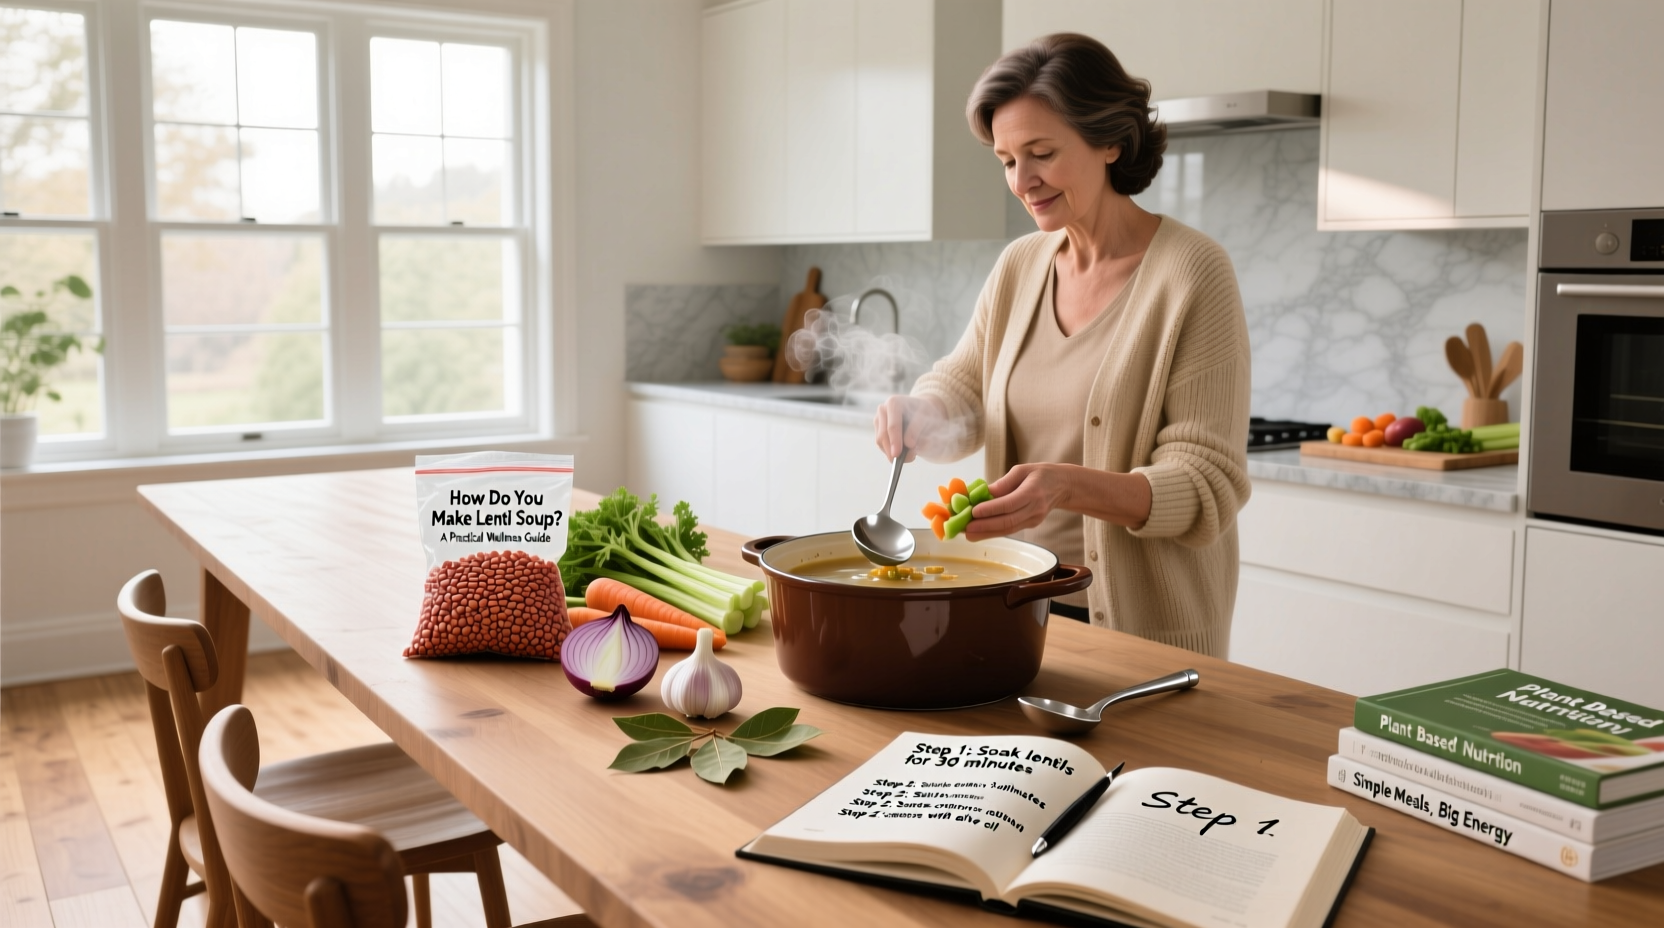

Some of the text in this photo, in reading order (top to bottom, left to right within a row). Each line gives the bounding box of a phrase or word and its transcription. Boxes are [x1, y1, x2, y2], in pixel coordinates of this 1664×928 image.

[450, 489, 544, 506] How Do You
[432, 510, 472, 526] Make
[516, 509, 563, 531] Soup?
[440, 532, 448, 543] A
[524, 531, 551, 543] Guide
[1379, 714, 1413, 739] Plant
[1416, 725, 1458, 753] Based
[905, 754, 931, 766] for
[934, 756, 960, 767] 30
[912, 743, 952, 757] Step
[977, 745, 1021, 759] Soak
[1141, 790, 1238, 836] Step
[1353, 771, 1392, 799] Simple
[1394, 786, 1434, 817] Meals,
[1438, 801, 1460, 827] Big
[1463, 811, 1513, 847] Energy
